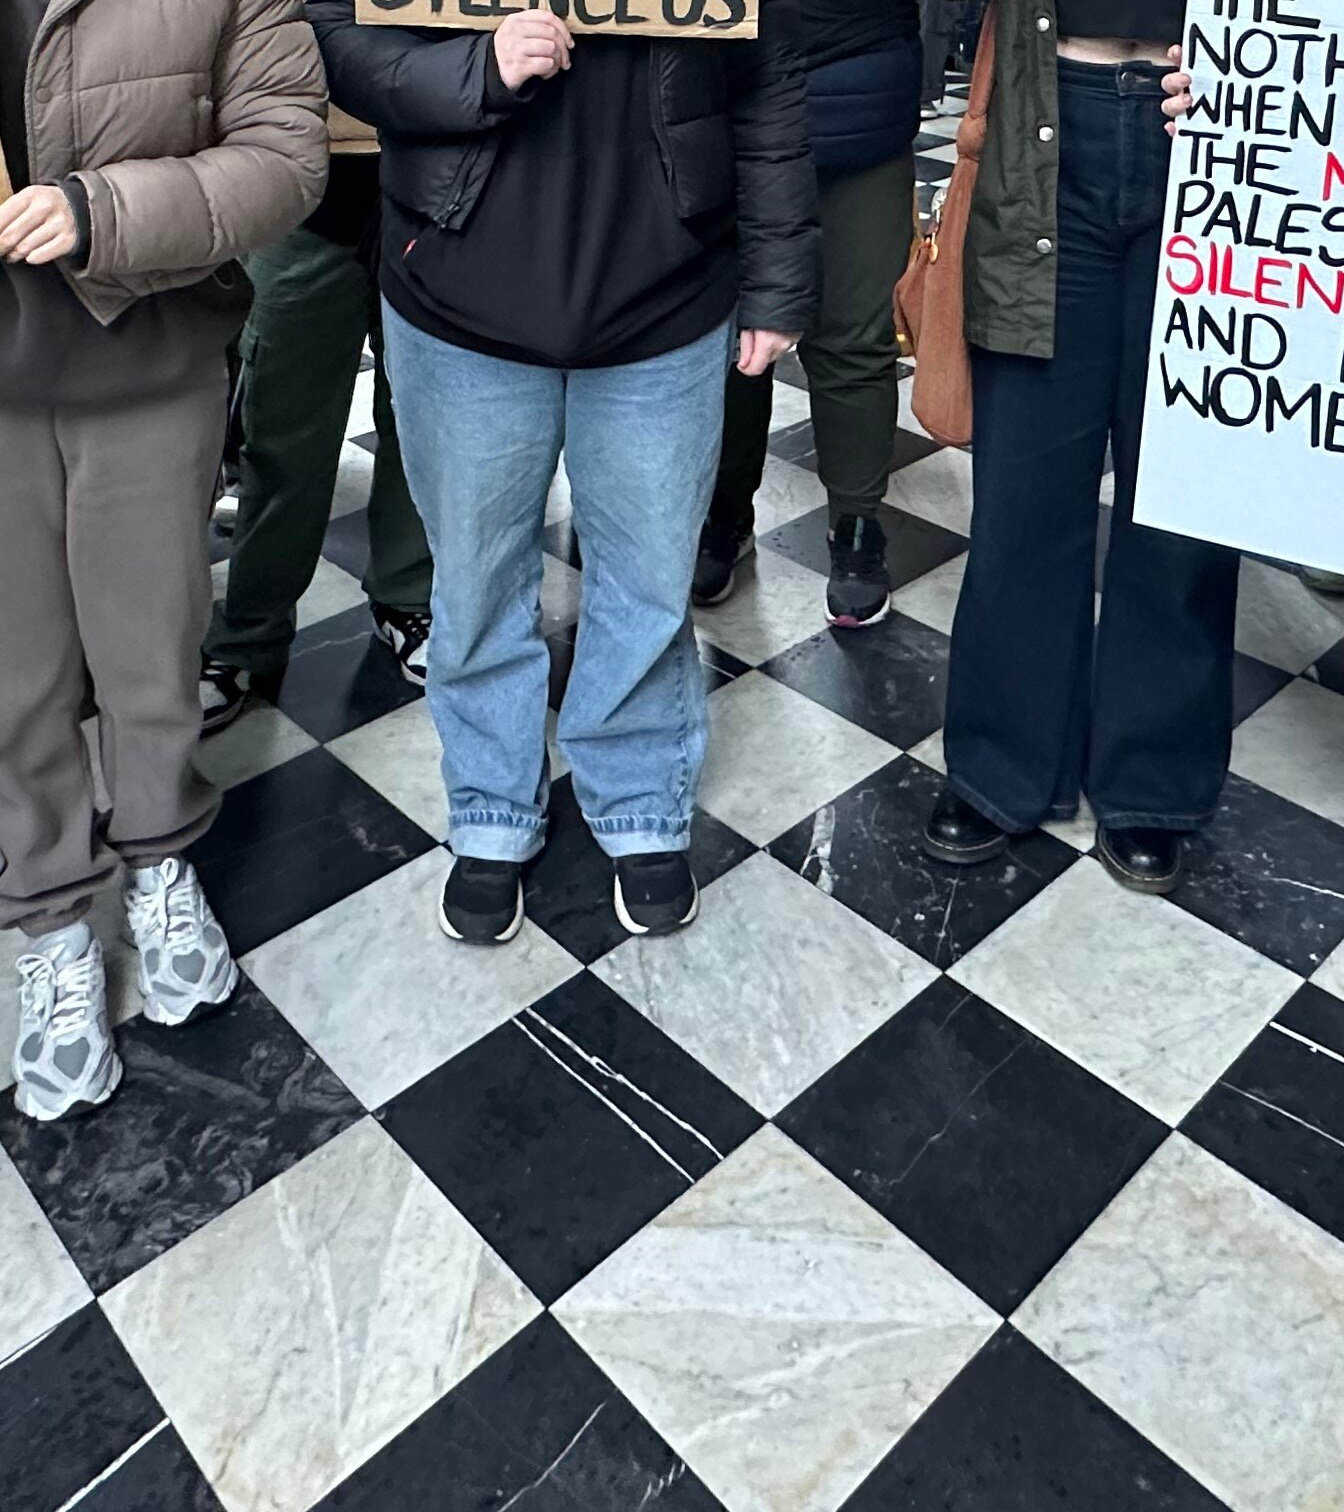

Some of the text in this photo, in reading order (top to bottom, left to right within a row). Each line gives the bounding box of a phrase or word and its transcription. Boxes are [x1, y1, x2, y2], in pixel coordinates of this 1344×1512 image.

[1186, 81, 1337, 148] WHEN
[1178, 129, 1300, 196] THE
[1164, 298, 1287, 370] AND
